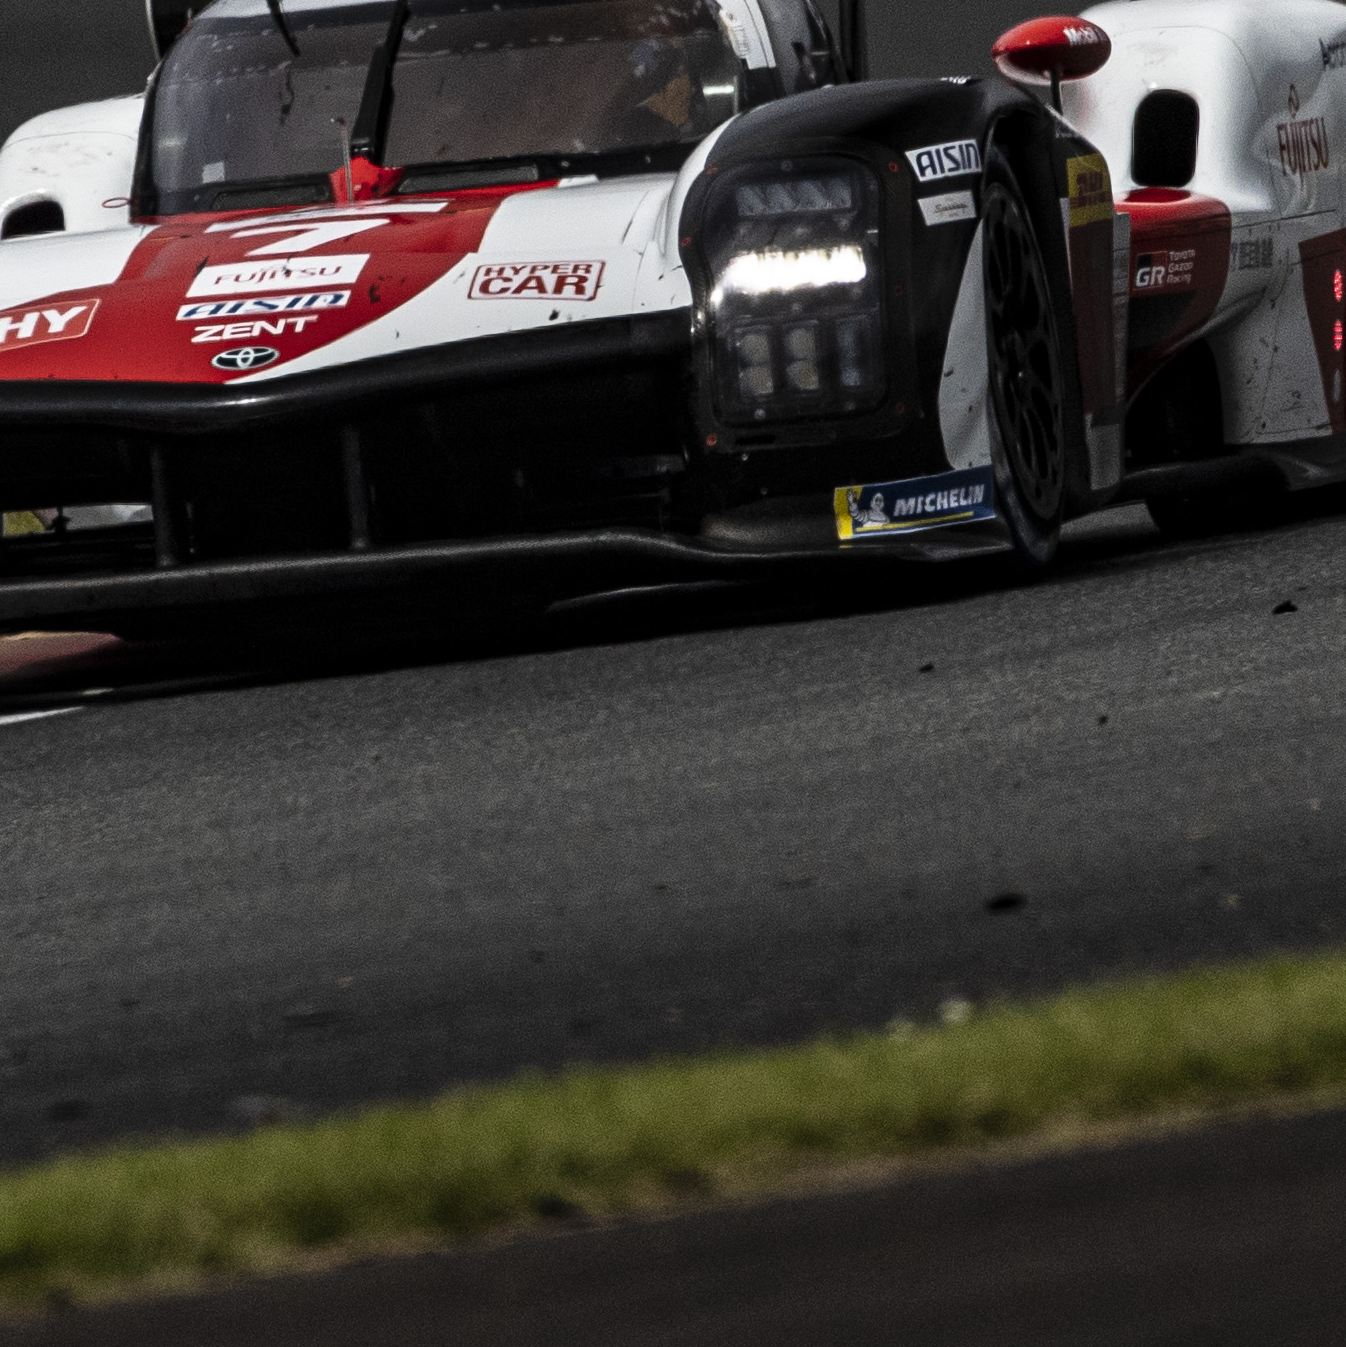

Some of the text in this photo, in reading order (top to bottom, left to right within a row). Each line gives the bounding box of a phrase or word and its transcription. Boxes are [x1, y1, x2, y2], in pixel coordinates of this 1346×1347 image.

[916, 142, 980, 177] AISIN
[1276, 117, 1330, 180] FUJITSU
[228, 217, 392, 257] 7
[213, 265, 343, 286] FUJITSU
[484, 264, 593, 277] HYPER
[1135, 266, 1165, 288] GR
[479, 275, 588, 295] CAR
[182, 292, 345, 318] AISIN
[191, 314, 320, 344] ZENT
[893, 484, 986, 518] MICHELIN
